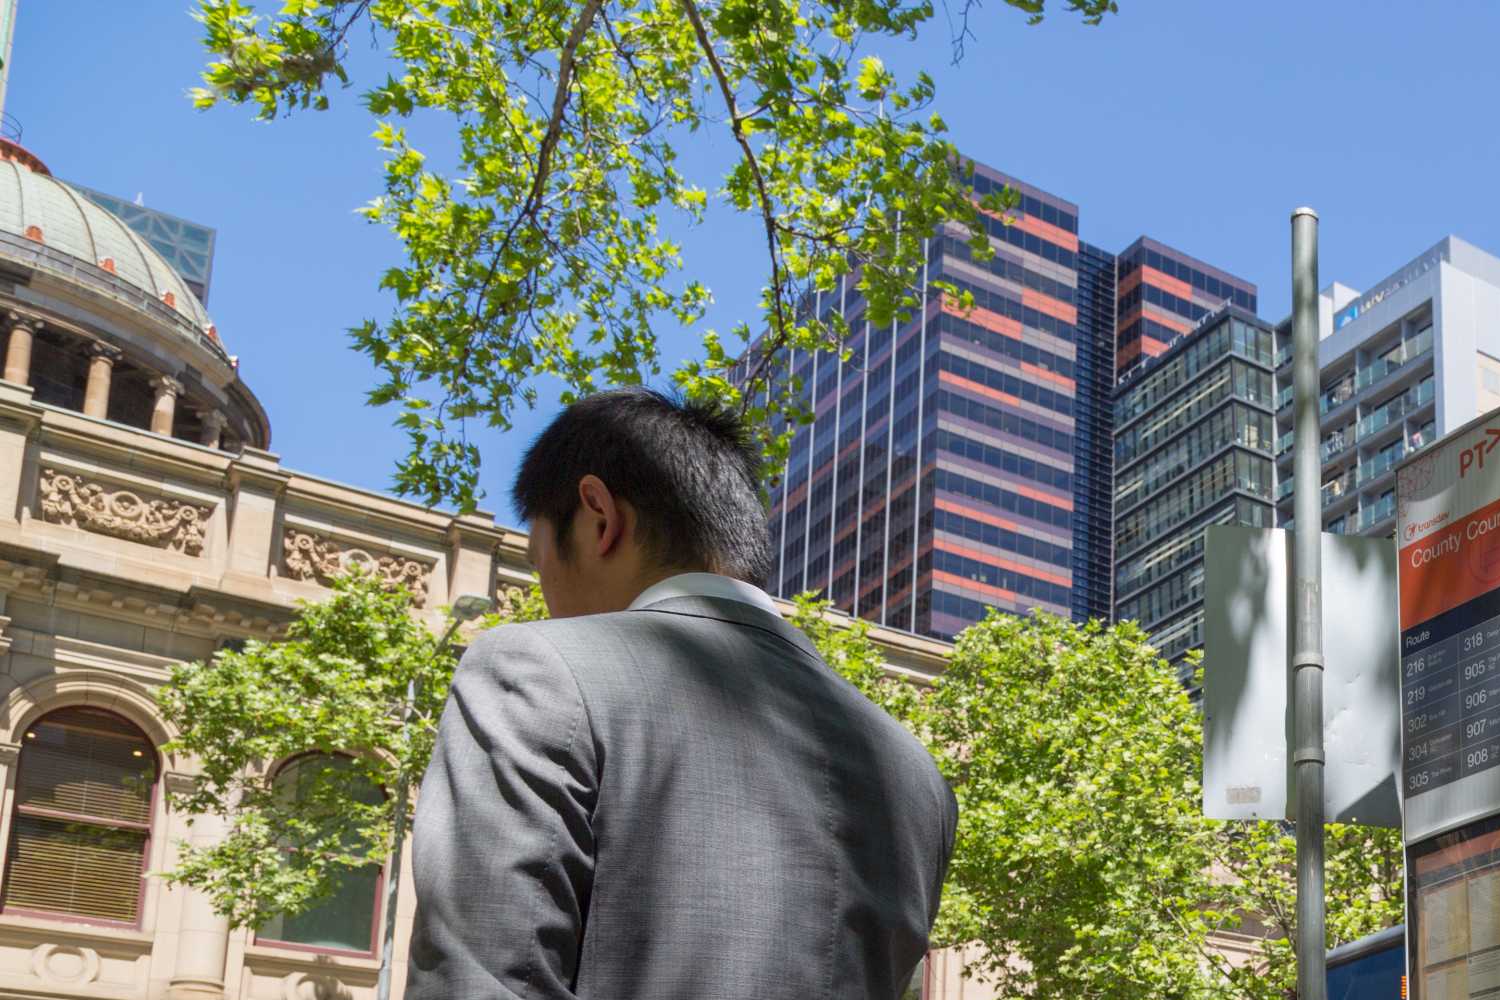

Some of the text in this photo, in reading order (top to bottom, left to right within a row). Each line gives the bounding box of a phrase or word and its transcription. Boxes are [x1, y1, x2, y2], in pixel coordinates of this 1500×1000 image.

[1411, 529, 1462, 568] County
[1405, 630, 1431, 648] Route
[1464, 632, 1484, 651] 318
[1406, 658, 1425, 677] 216
[1464, 660, 1486, 681] 905
[1407, 686, 1426, 705] 219
[1465, 689, 1487, 710] 906
[1407, 714, 1427, 733] 302
[1466, 718, 1487, 739] 907
[1408, 742, 1428, 762] 304
[1467, 748, 1489, 768] 908
[1408, 771, 1429, 790] 305
